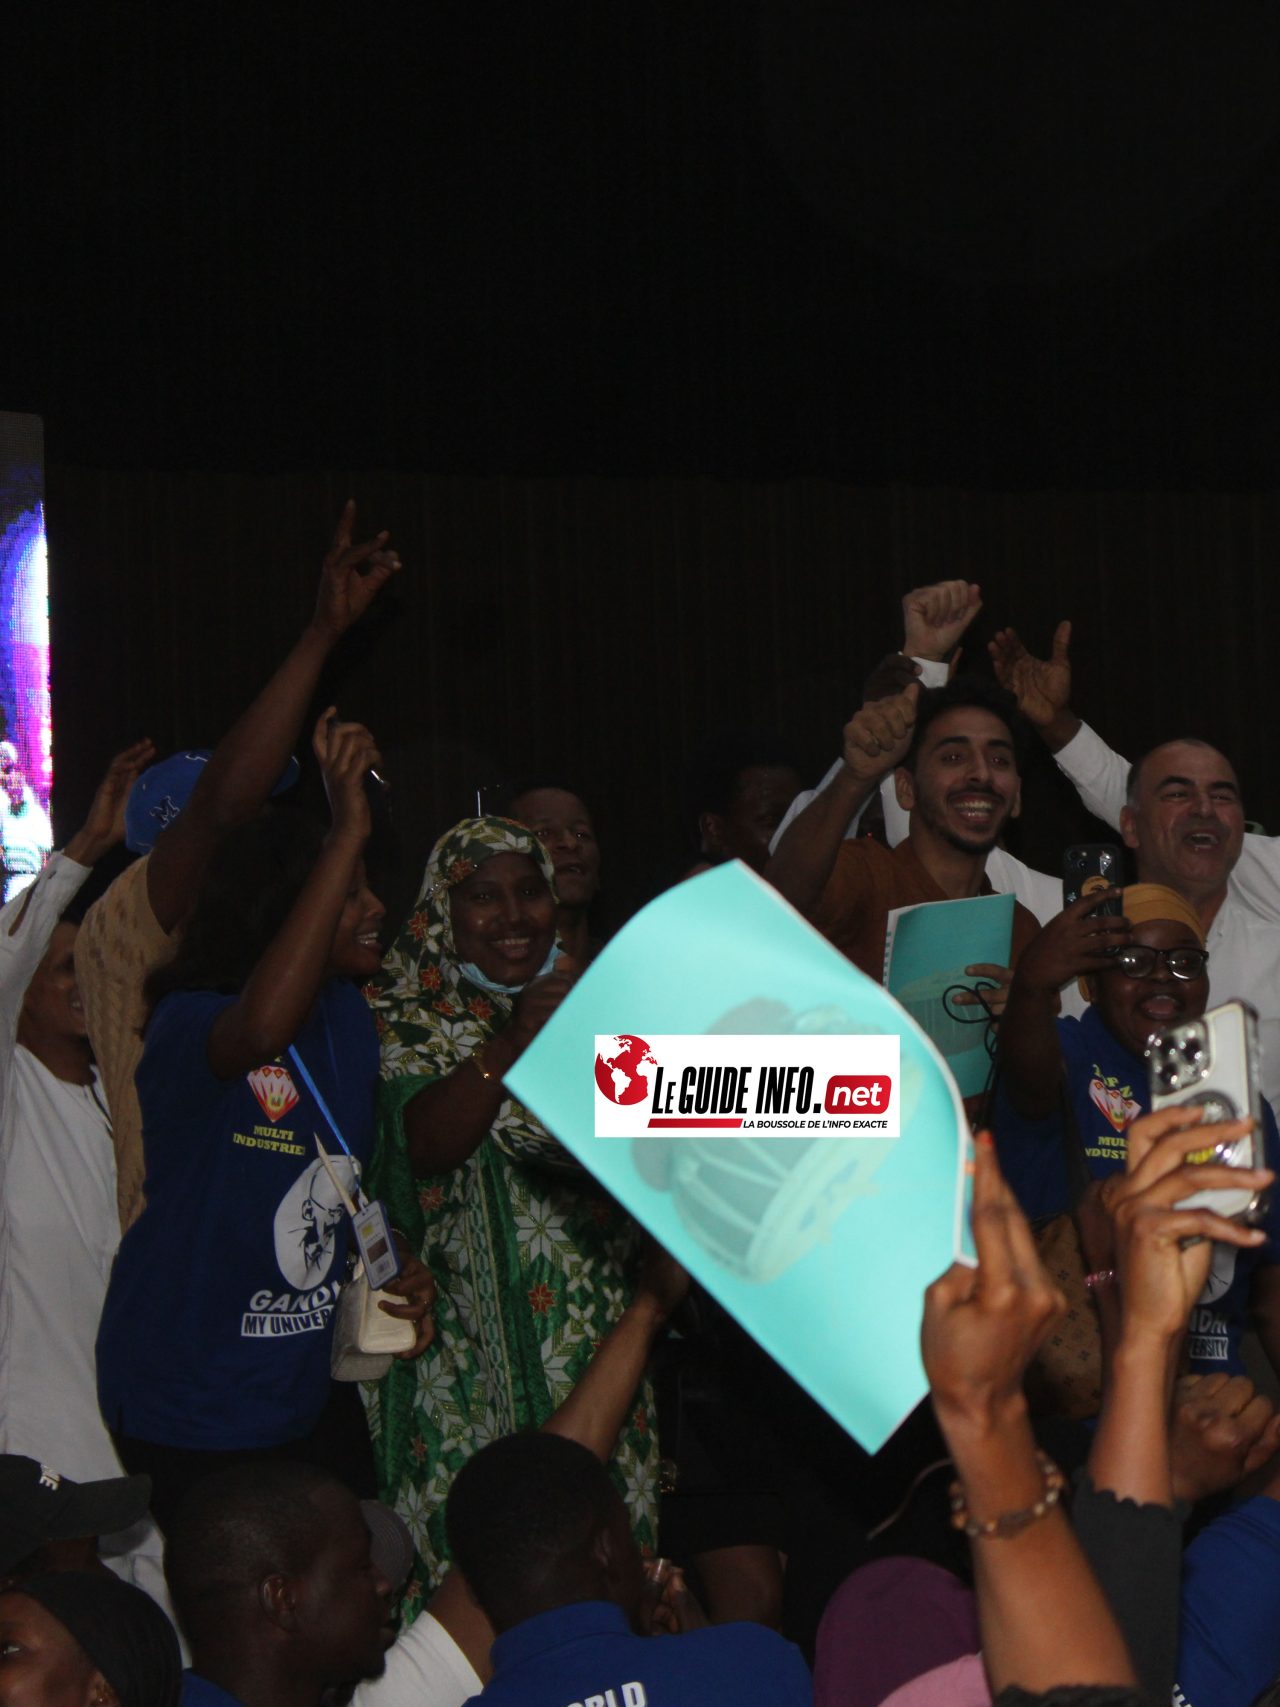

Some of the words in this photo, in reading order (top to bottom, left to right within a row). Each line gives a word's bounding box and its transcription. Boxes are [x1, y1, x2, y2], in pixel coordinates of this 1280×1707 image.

[253, 1125, 295, 1141] MULTI
[232, 1132, 306, 1156] INDUSTRIE
[244, 1315, 268, 1335] MY
